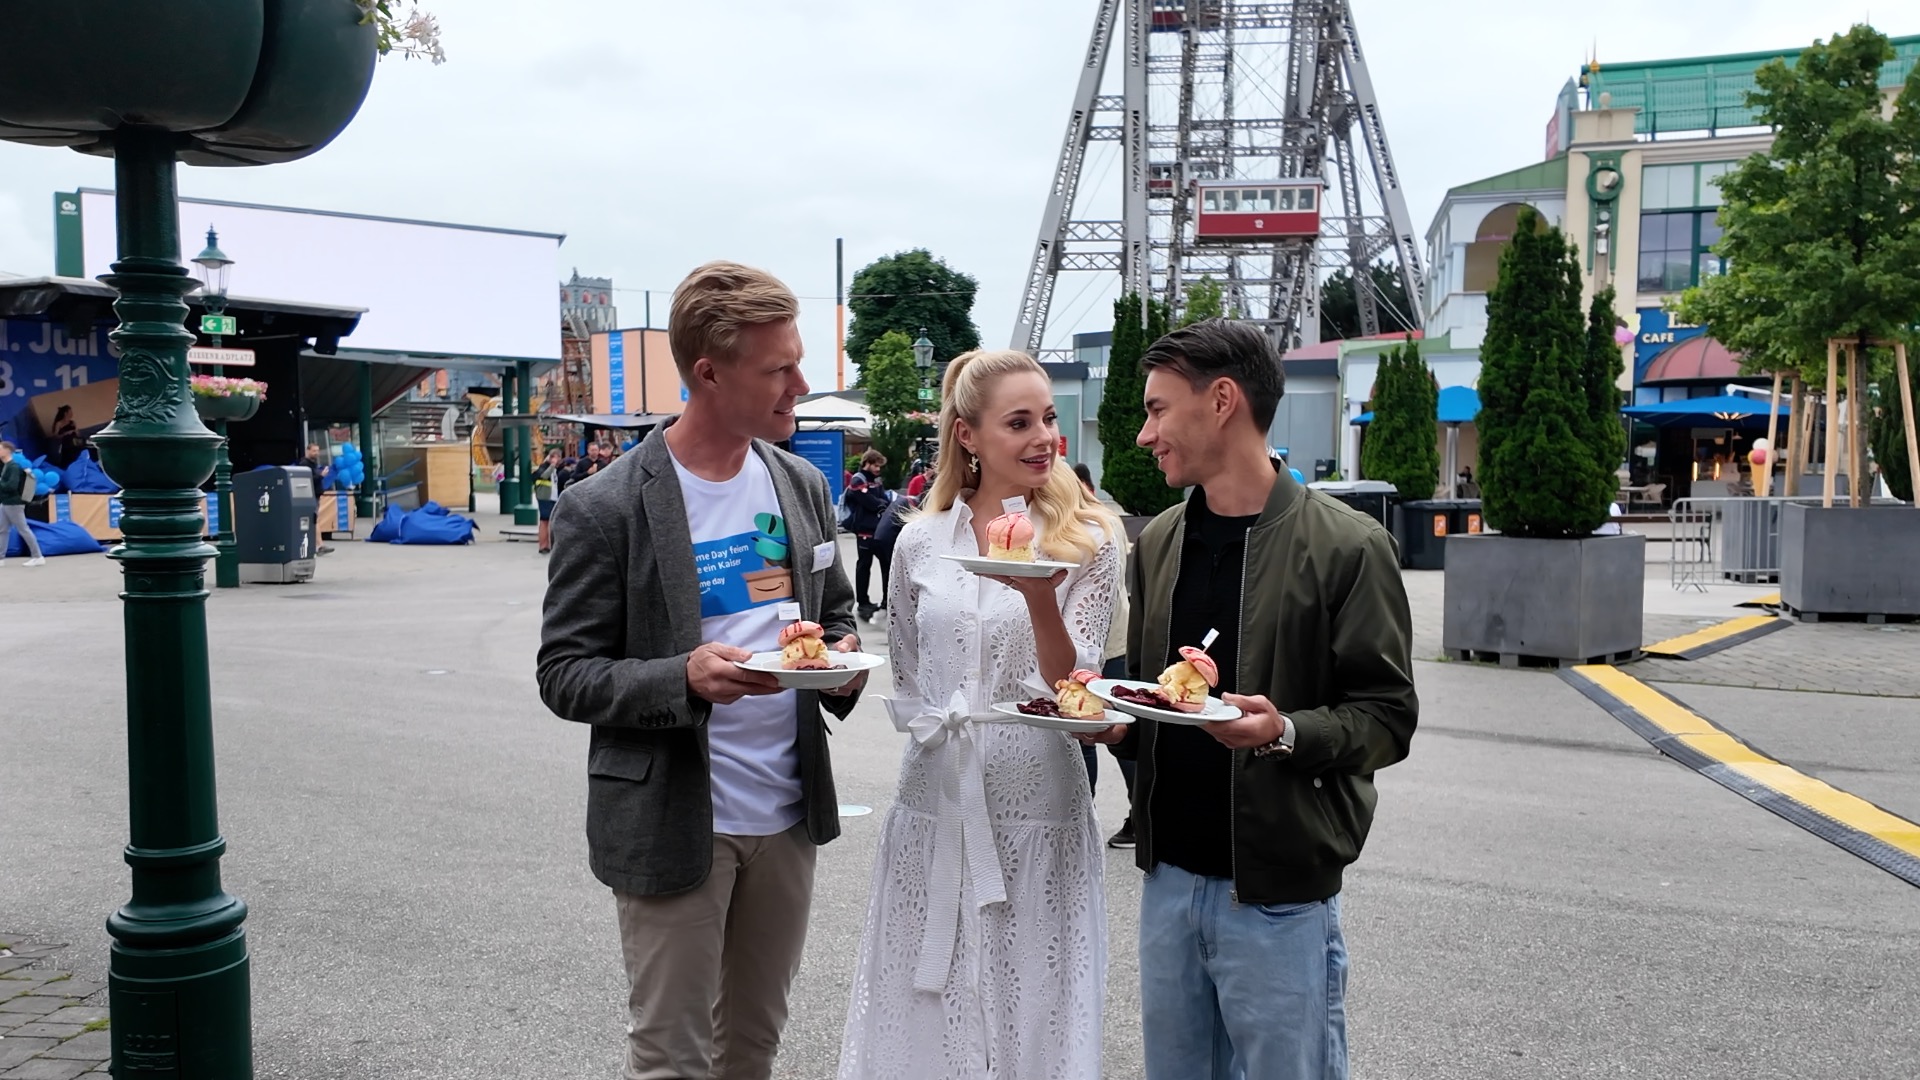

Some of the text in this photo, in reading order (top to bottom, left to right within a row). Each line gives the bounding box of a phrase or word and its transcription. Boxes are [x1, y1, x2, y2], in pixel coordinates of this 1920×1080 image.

[1642, 332, 1674, 343] CAFE
[188, 351, 254, 362] RIESENRADPLATZ
[711, 550, 728, 559] Day
[703, 563, 716, 573] ein
[718, 559, 741, 569] Kaiser
[712, 577, 725, 585] day
